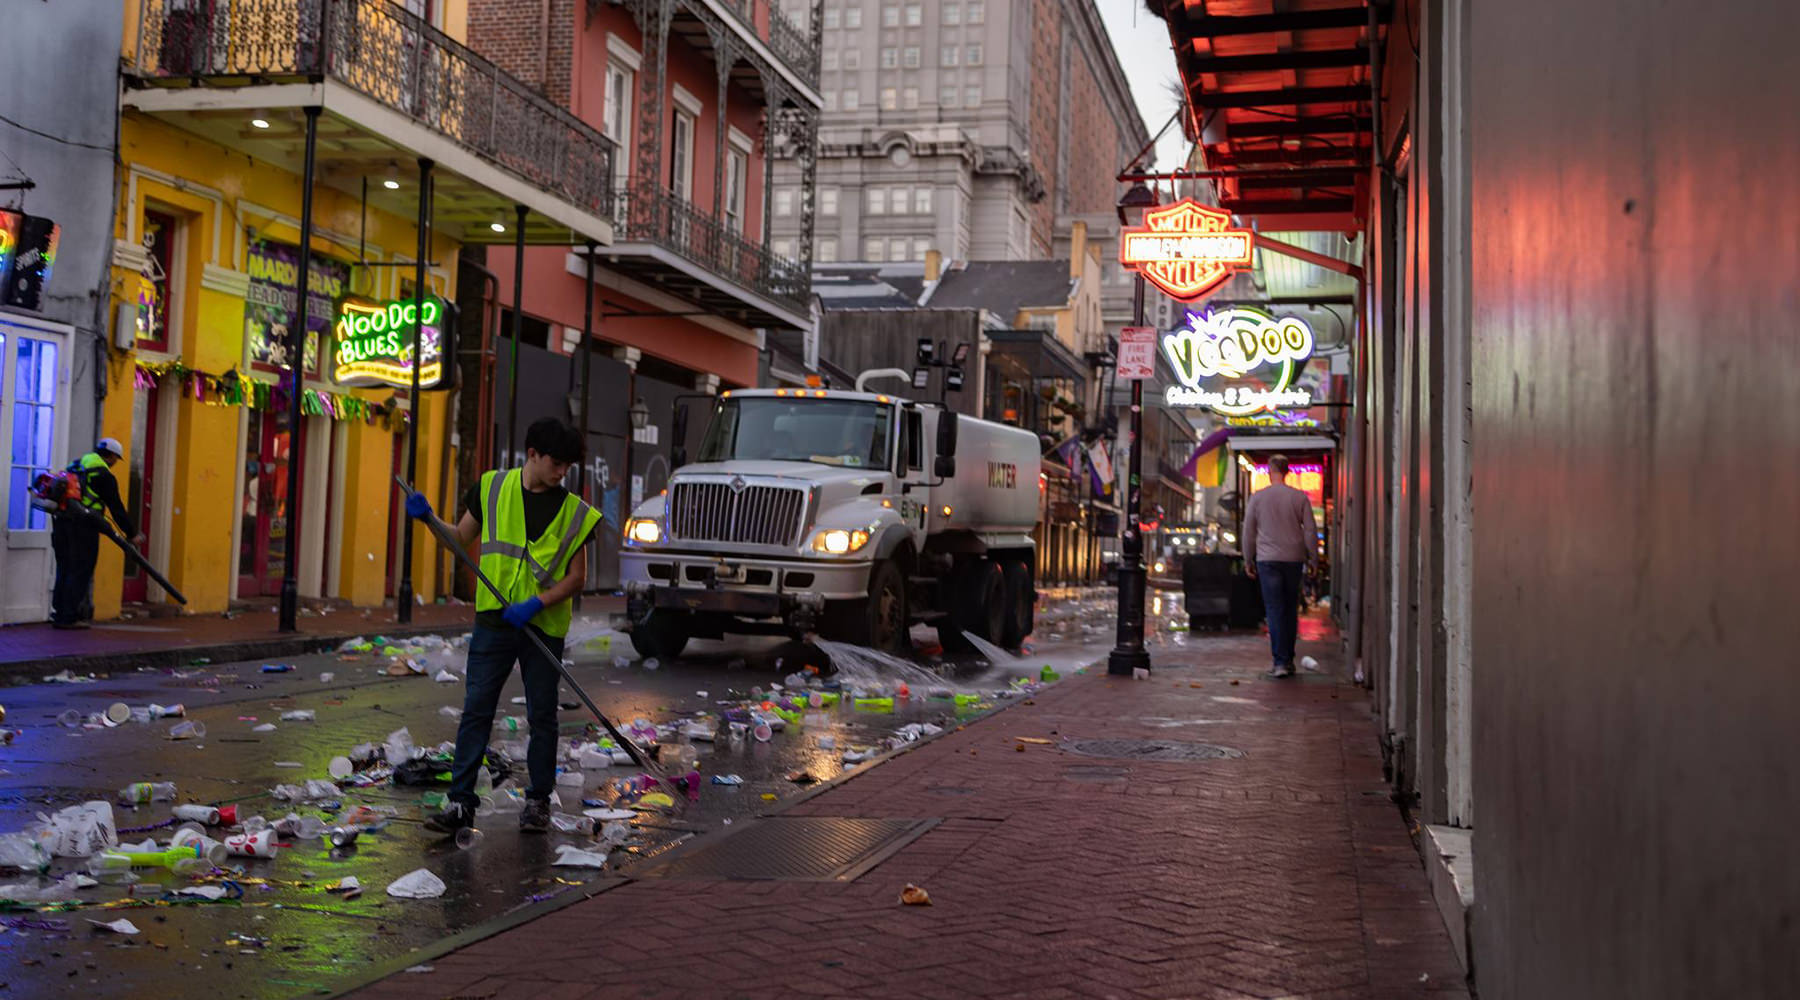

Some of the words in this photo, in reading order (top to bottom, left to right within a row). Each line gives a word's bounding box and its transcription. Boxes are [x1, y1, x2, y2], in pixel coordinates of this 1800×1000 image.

[1155, 261, 1217, 286] CYCLES
[341, 302, 436, 337] VOODOO
[341, 331, 399, 363] BLUES
[1126, 355, 1146, 364] LANE
[1127, 344, 1145, 353] FIRE
[1164, 318, 1313, 387] VOODOO
[988, 461, 1016, 489] WATER
